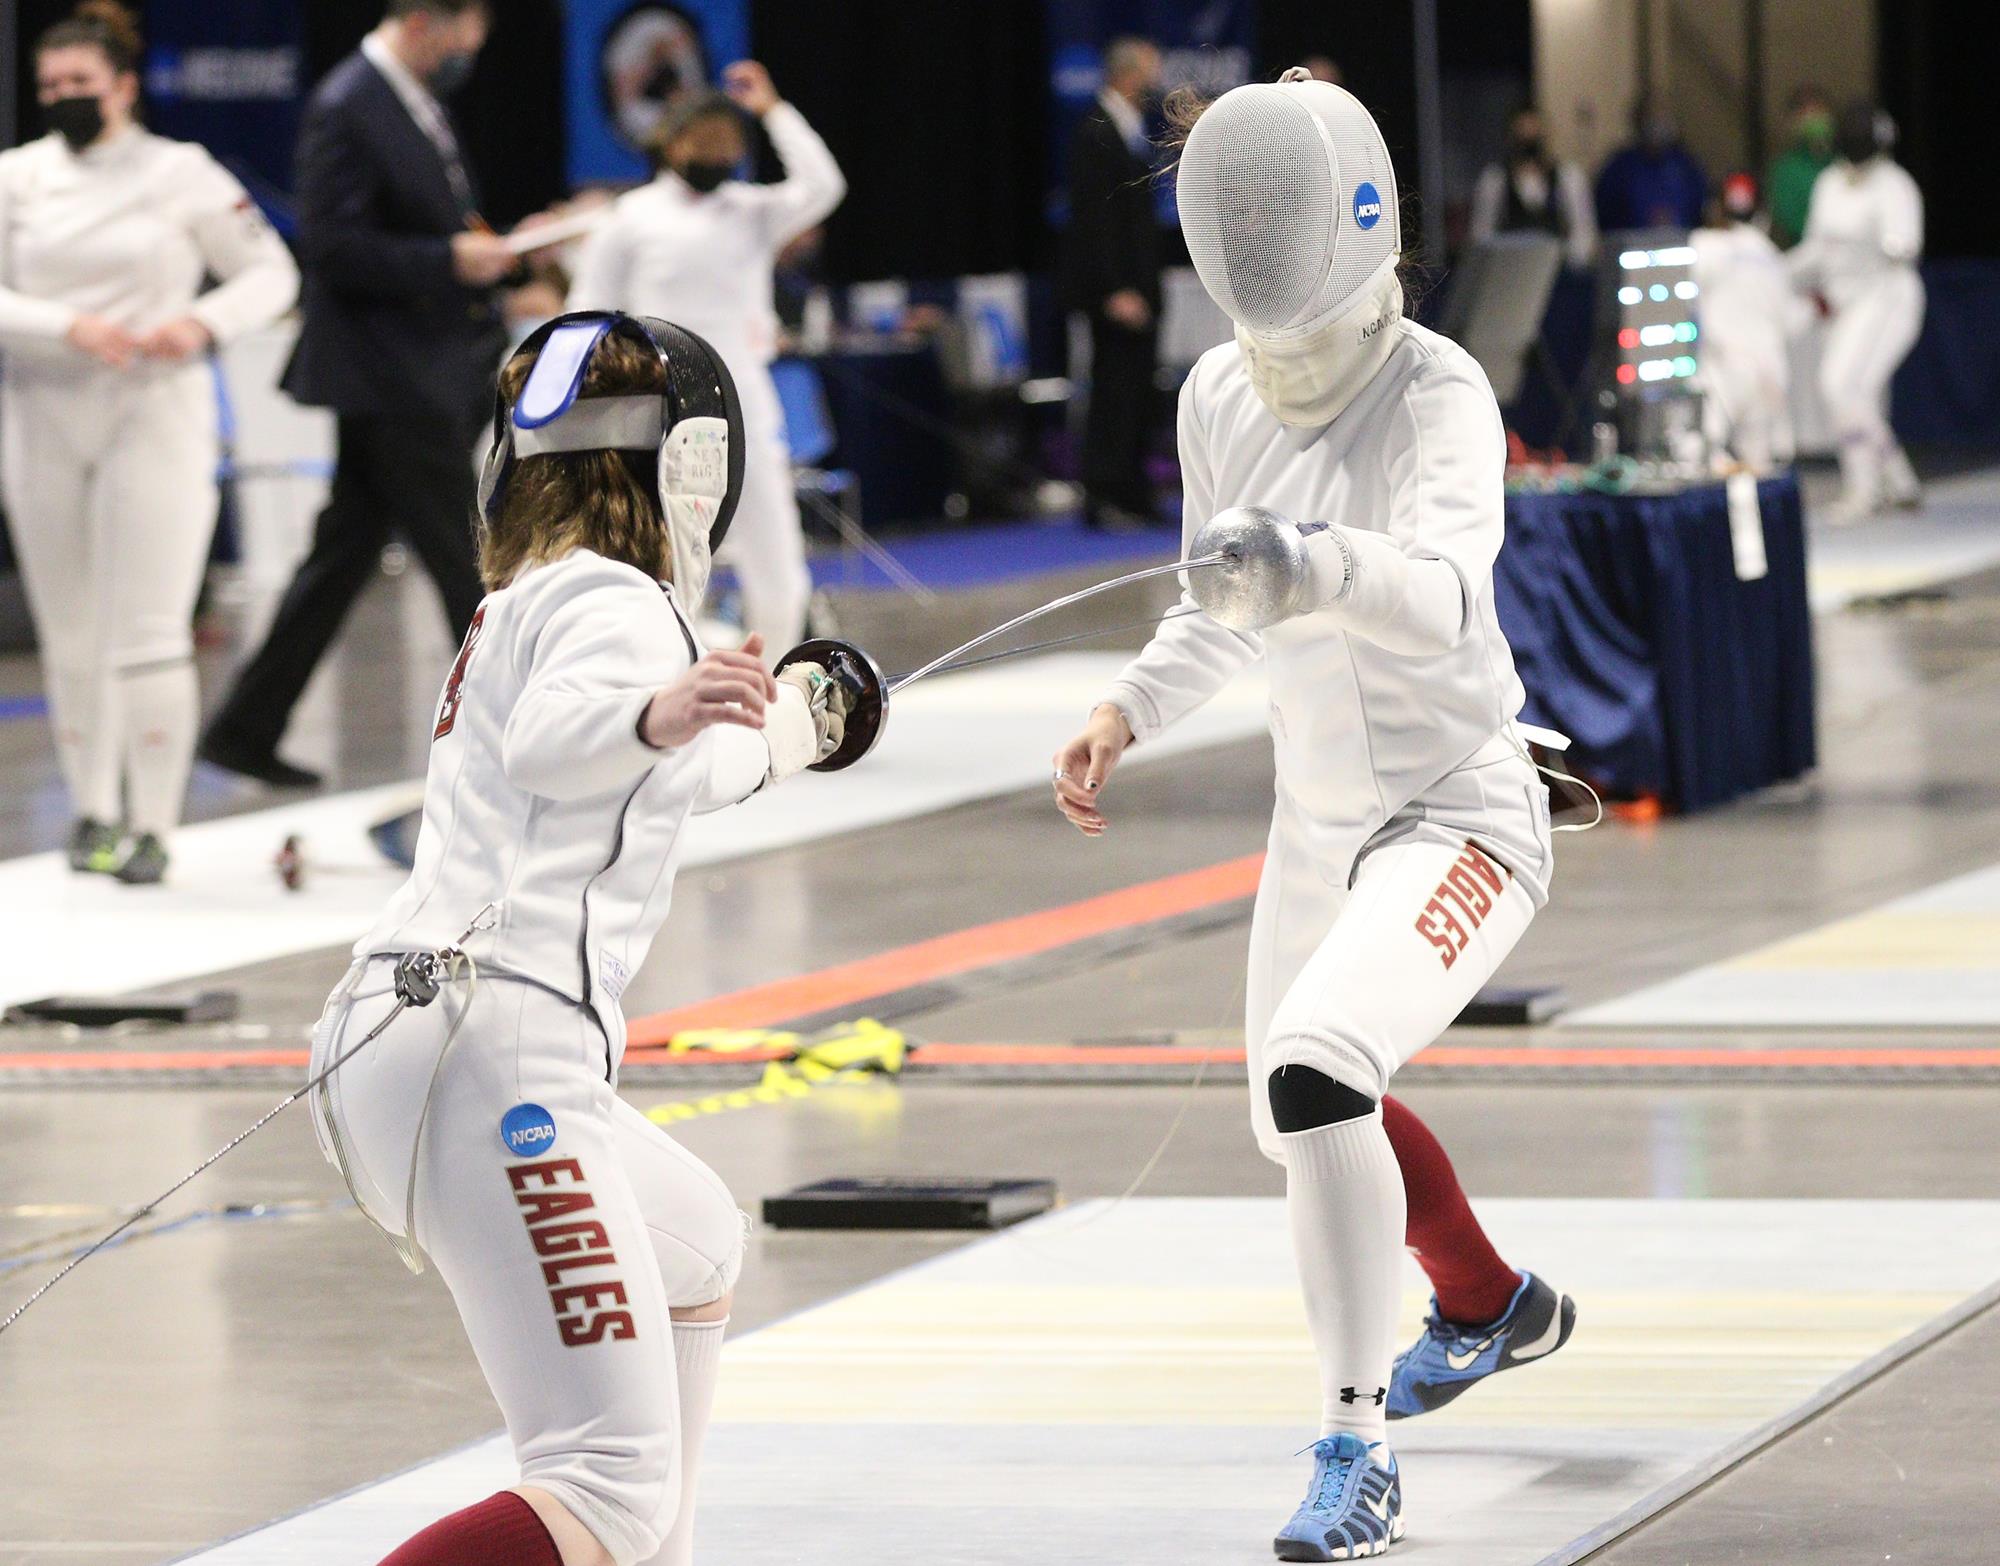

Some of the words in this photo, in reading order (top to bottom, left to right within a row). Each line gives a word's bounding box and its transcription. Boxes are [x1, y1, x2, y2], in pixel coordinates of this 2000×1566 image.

[1358, 203, 1381, 217] NCAA
[1414, 837, 1513, 971] AGLES
[510, 1123, 555, 1146] NCAA
[504, 1158, 638, 1348] EAGLES
